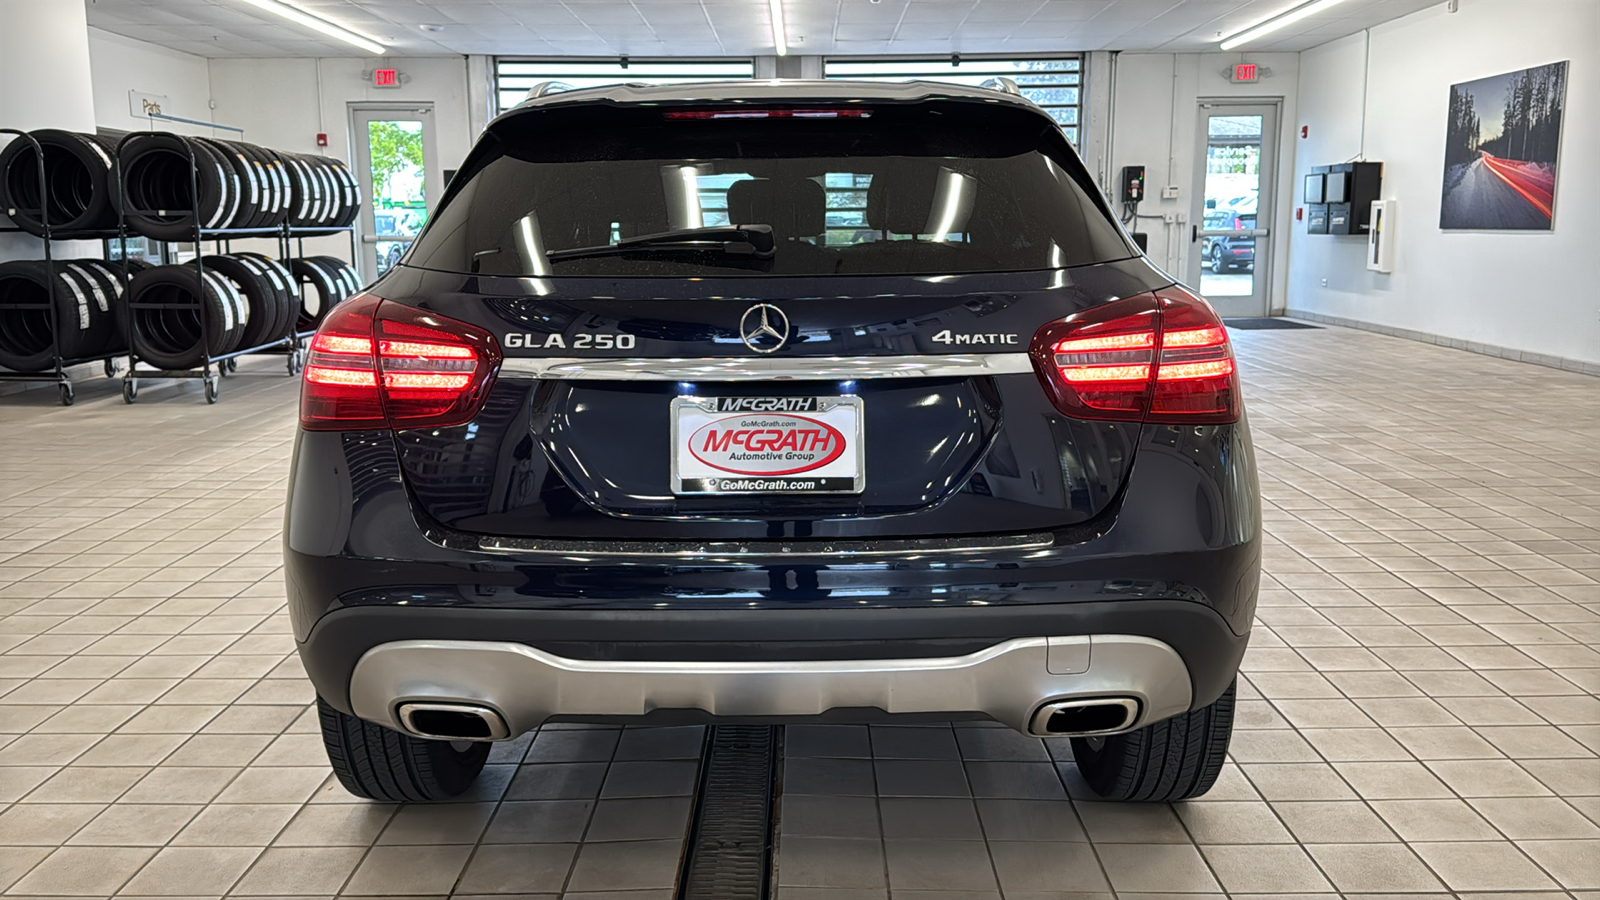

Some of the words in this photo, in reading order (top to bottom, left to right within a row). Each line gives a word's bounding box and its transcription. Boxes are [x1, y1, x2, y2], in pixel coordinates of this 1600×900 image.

[376, 69, 395, 85] EXIT
[1236, 64, 1256, 80] EXIT
[142, 98, 161, 115] Parts
[504, 333, 566, 349] GLA
[573, 334, 636, 350] 250
[931, 329, 1018, 345] 4MATIC
[740, 420, 797, 428] GoMcGrath.com
[729, 452, 784, 461] Automotive
[785, 452, 815, 462] Group
[721, 480, 815, 490] GoMcGrath.com
